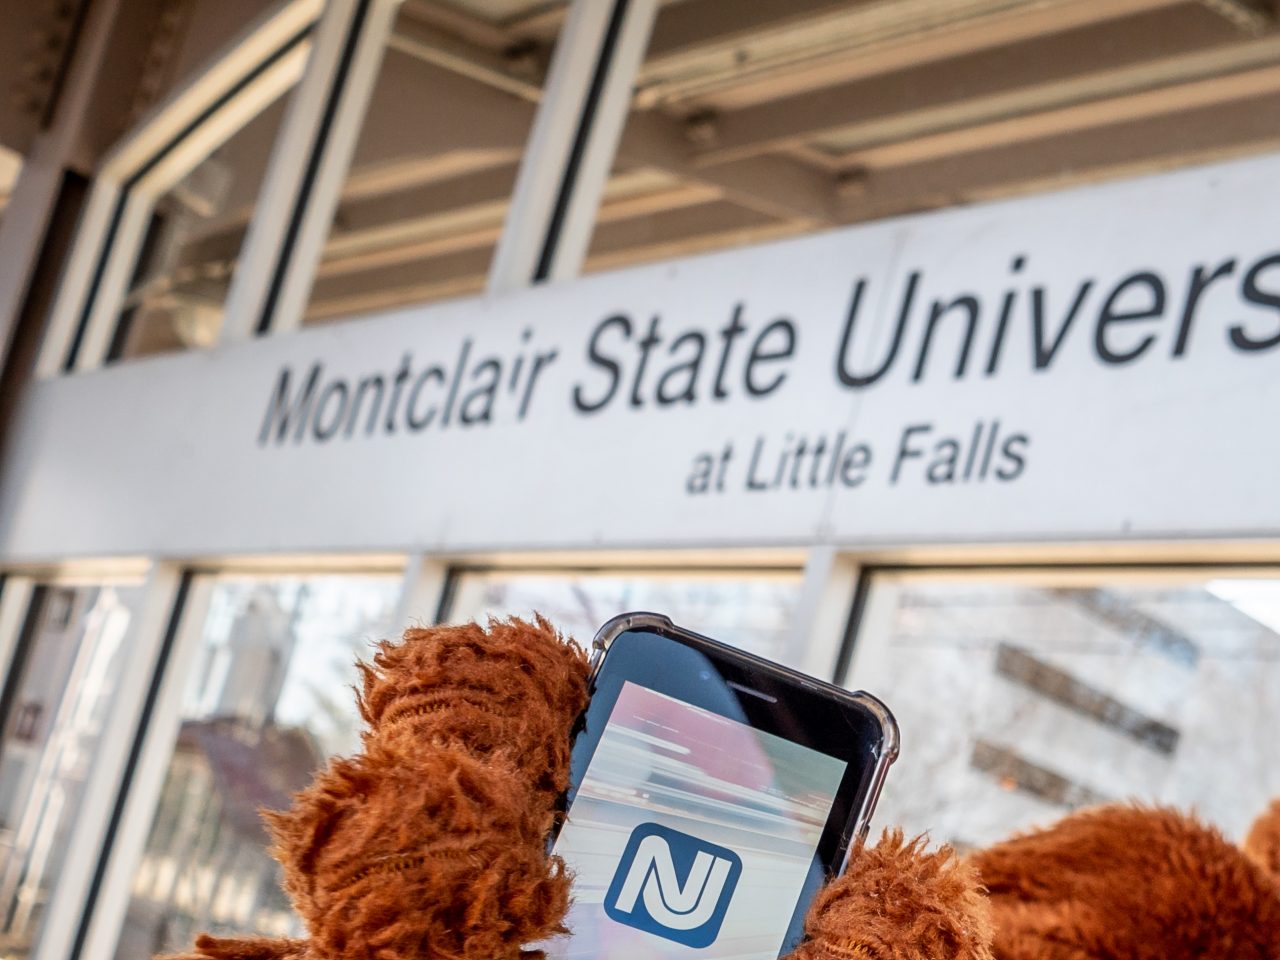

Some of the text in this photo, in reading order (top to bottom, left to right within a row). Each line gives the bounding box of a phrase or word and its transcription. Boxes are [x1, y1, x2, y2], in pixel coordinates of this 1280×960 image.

[257, 328, 560, 446] Montclair
[570, 303, 799, 415] State
[684, 420, 1034, 498] at Little Falls
